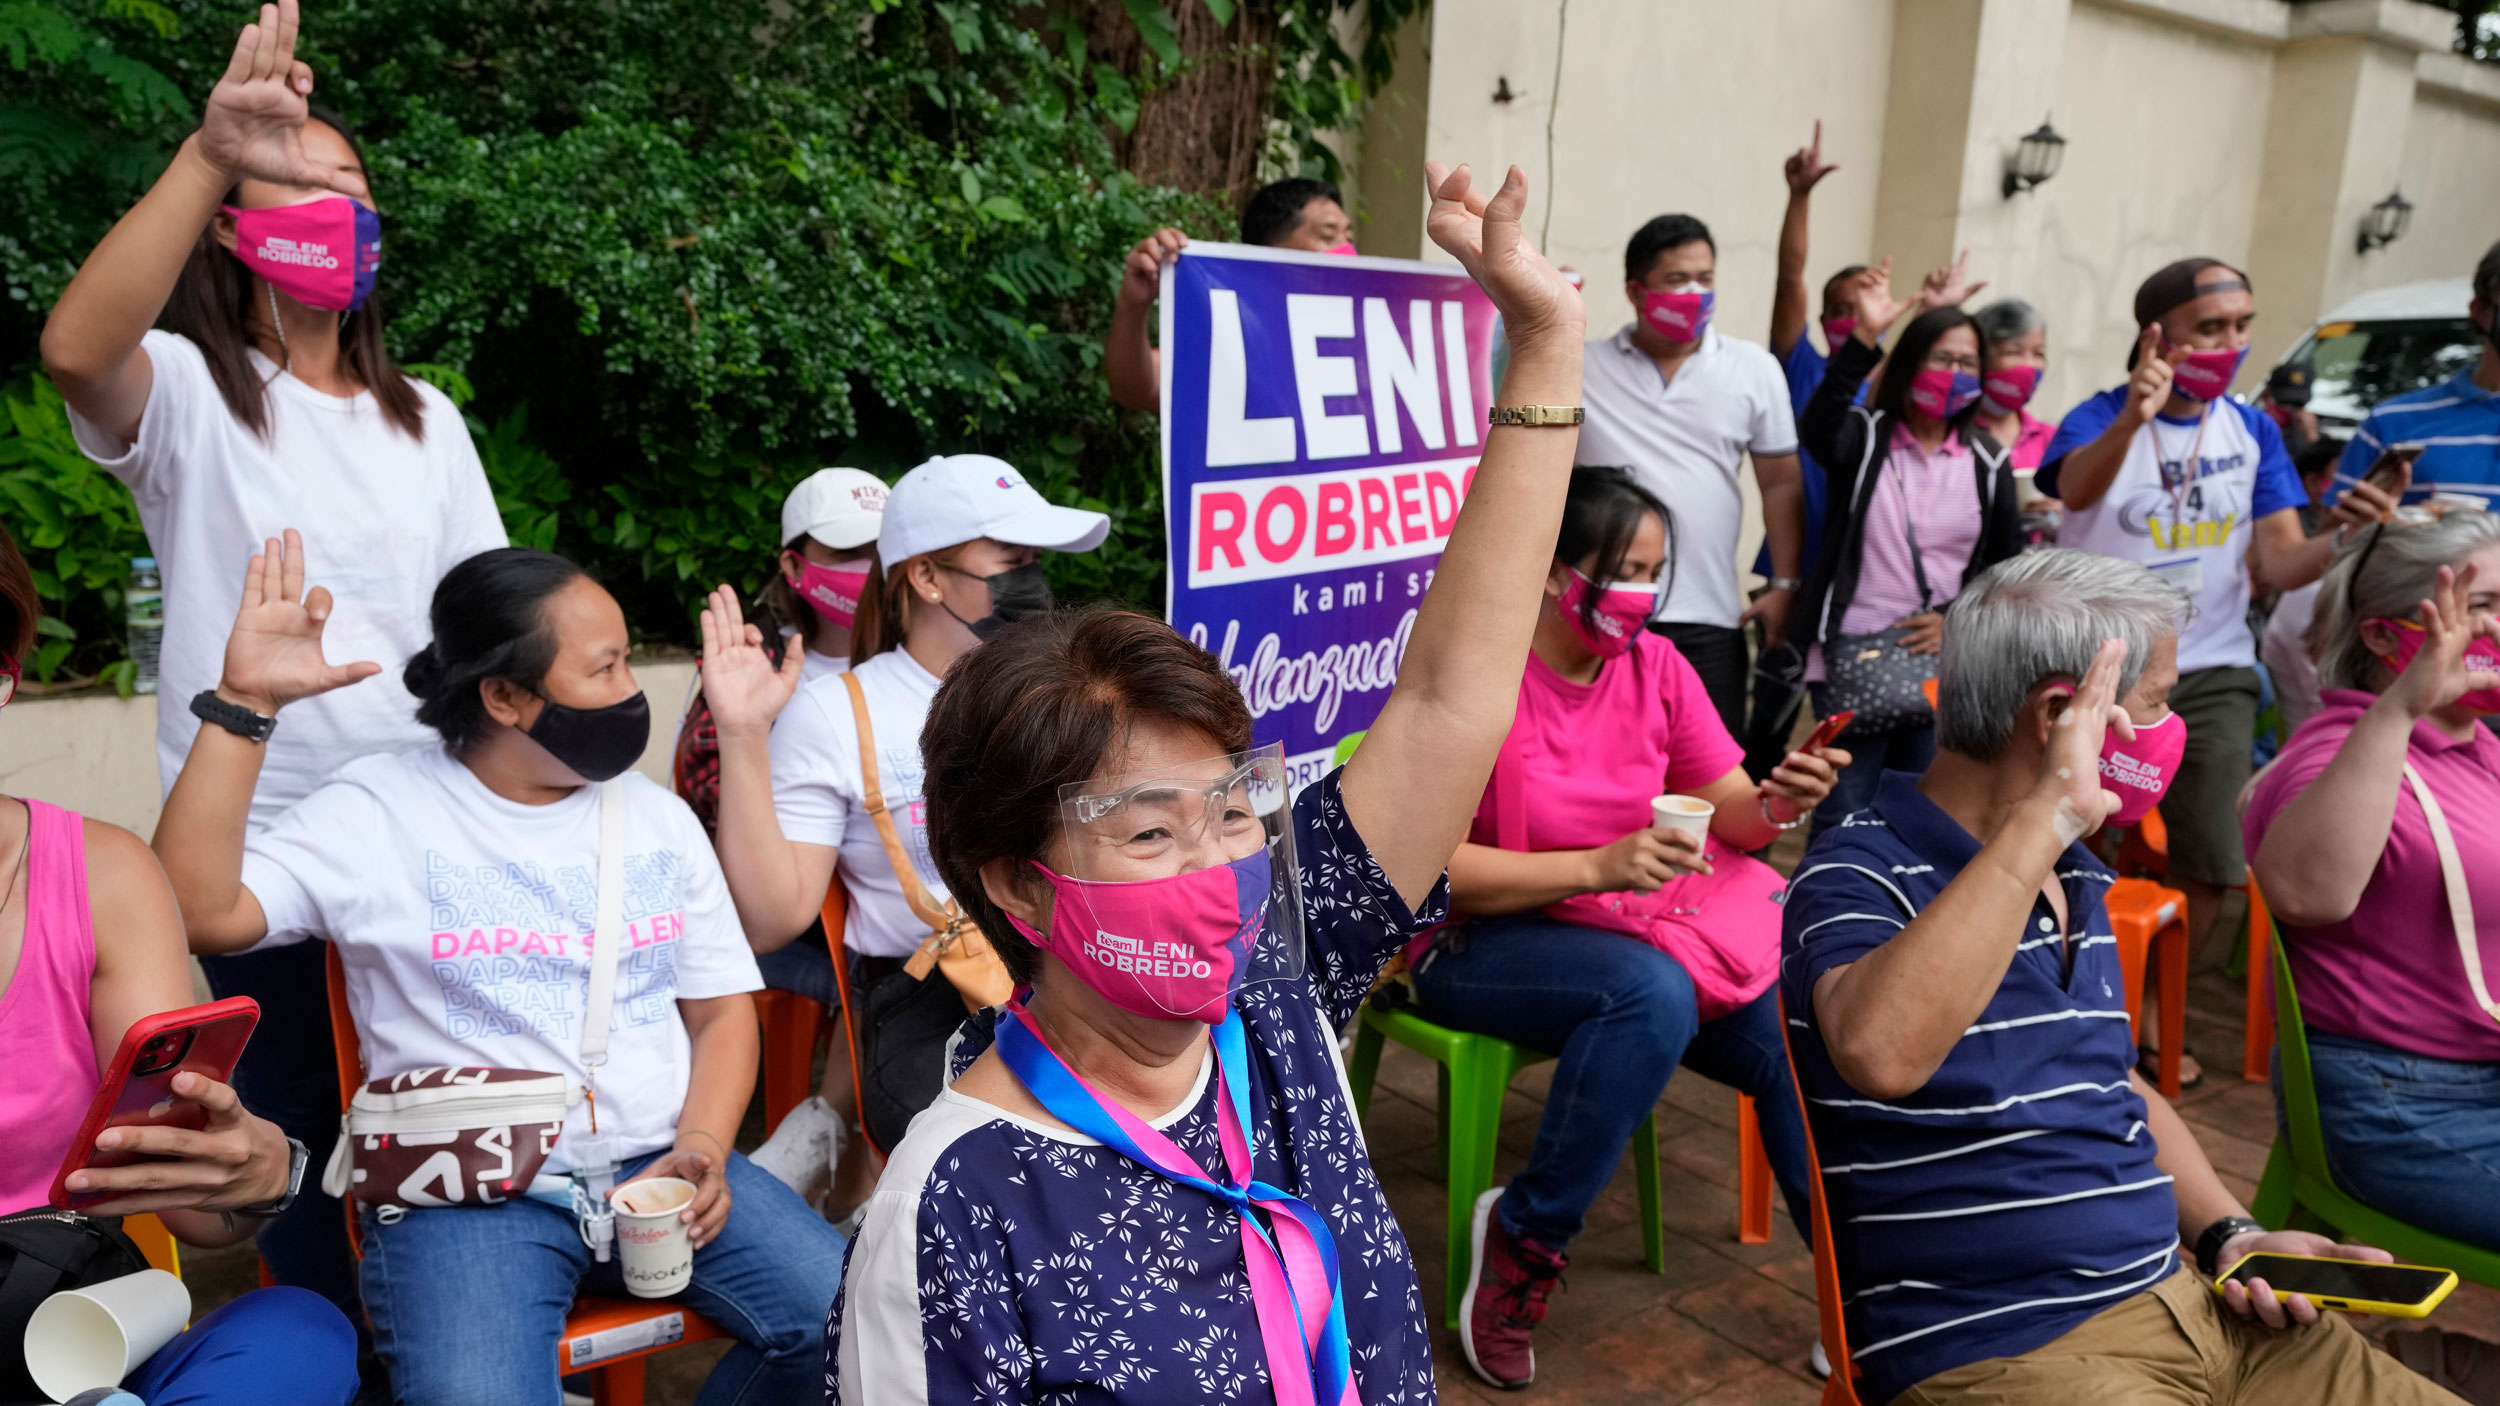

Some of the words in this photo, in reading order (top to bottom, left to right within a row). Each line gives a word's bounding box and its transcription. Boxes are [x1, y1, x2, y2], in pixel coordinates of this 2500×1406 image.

[1206, 288, 1479, 467] LENI
[2187, 486, 2204, 511] 4
[2147, 513, 2236, 550] Leni
[1293, 571, 1384, 616] kami
[2133, 760, 2162, 779] LENI
[622, 886, 683, 923] LEN
[432, 928, 569, 960] DAPAT
[628, 911, 684, 948] LEN
[1138, 939, 1195, 960] LENI
[432, 956, 574, 988] DAPAT
[1084, 939, 1211, 978] ROBREDO
